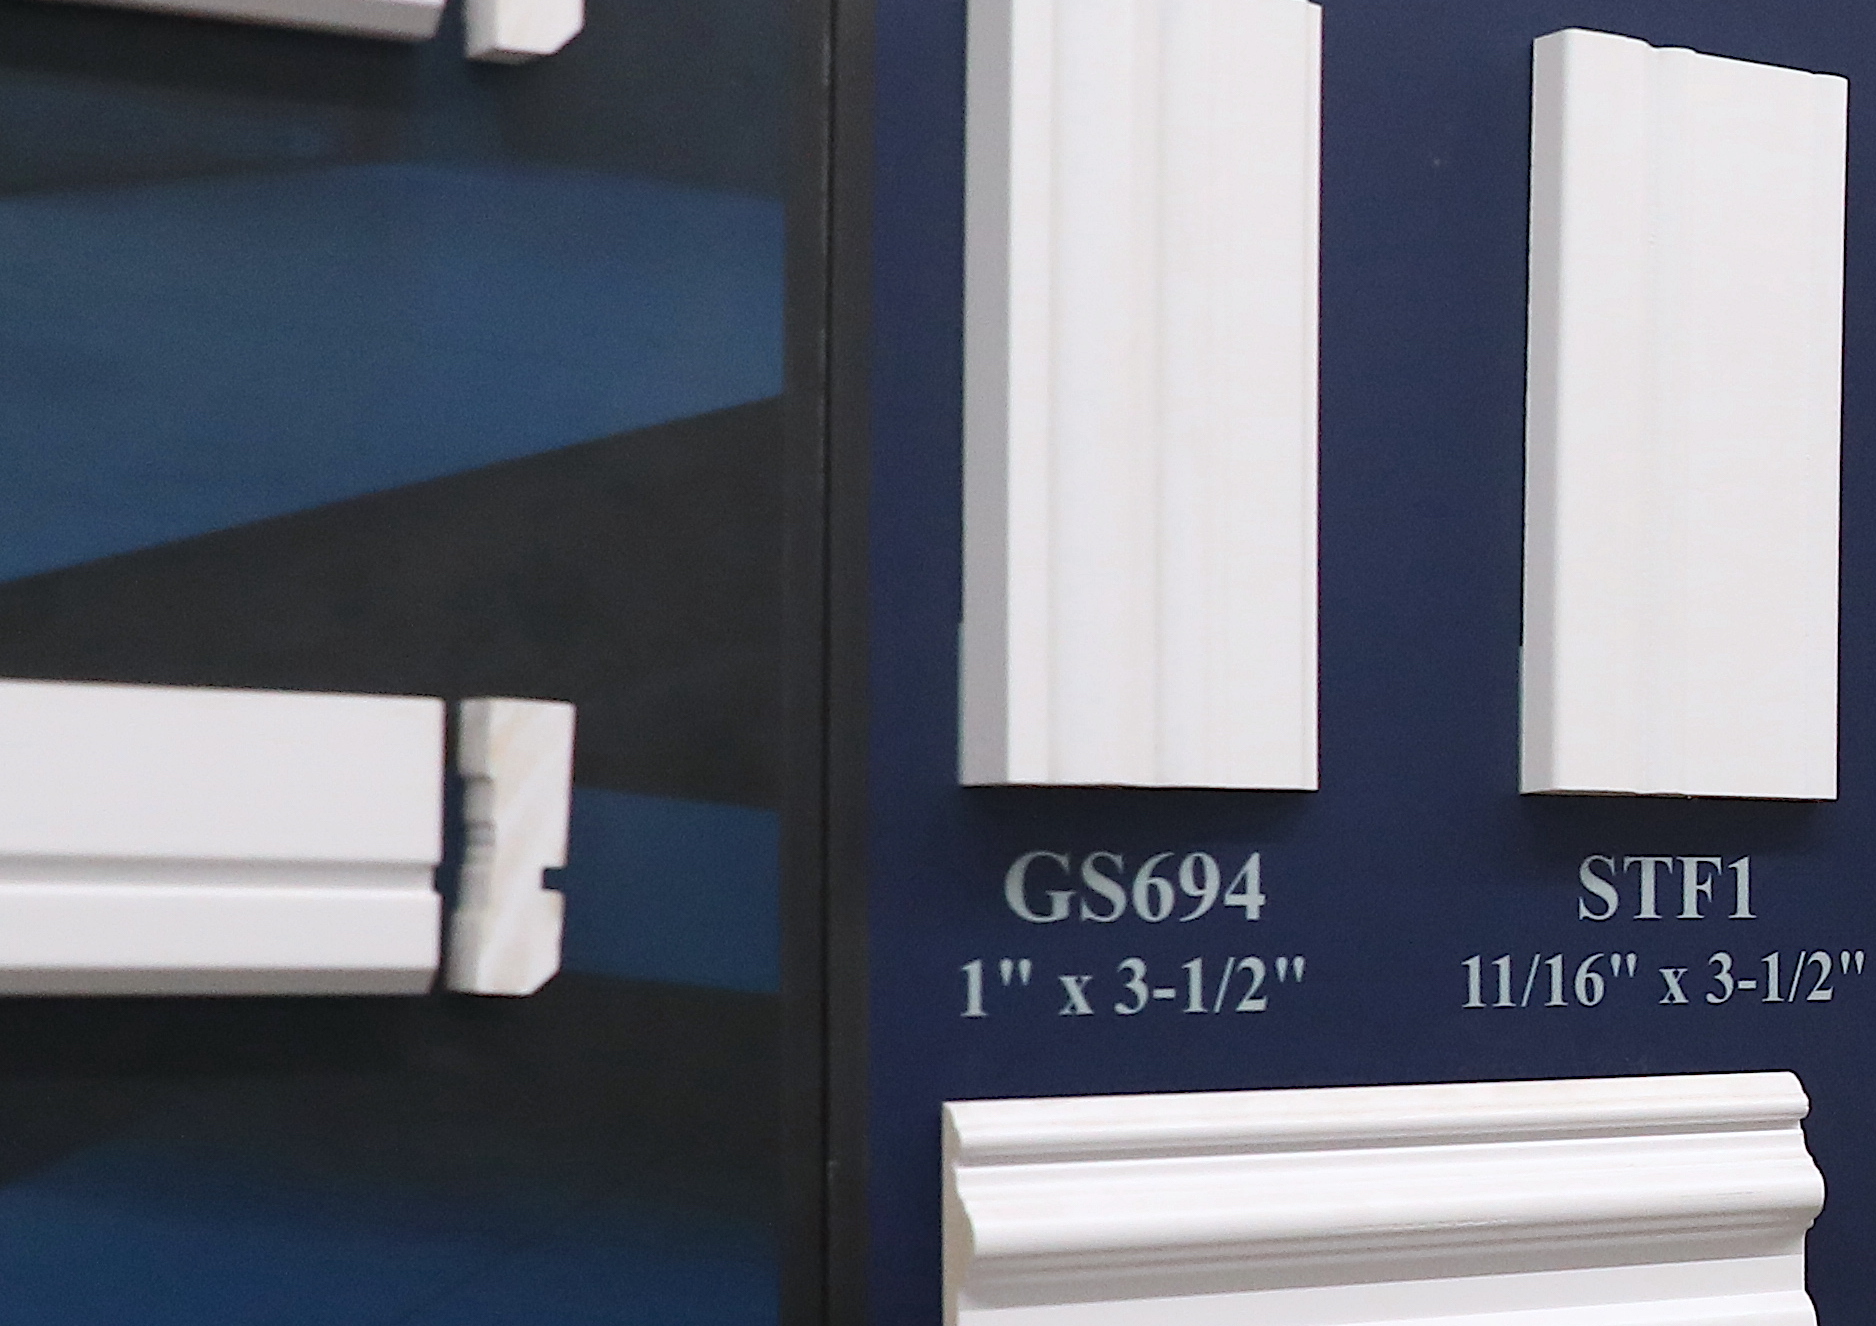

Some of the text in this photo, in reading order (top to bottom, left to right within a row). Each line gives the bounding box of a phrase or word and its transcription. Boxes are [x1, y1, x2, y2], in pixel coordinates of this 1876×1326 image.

[1004, 850, 1266, 923] GS694
[1578, 854, 1757, 920] STF1
[960, 956, 1307, 1018] 1" x 3-1/2"
[1461, 951, 1865, 1008] 11/16" x 3-1/2"
